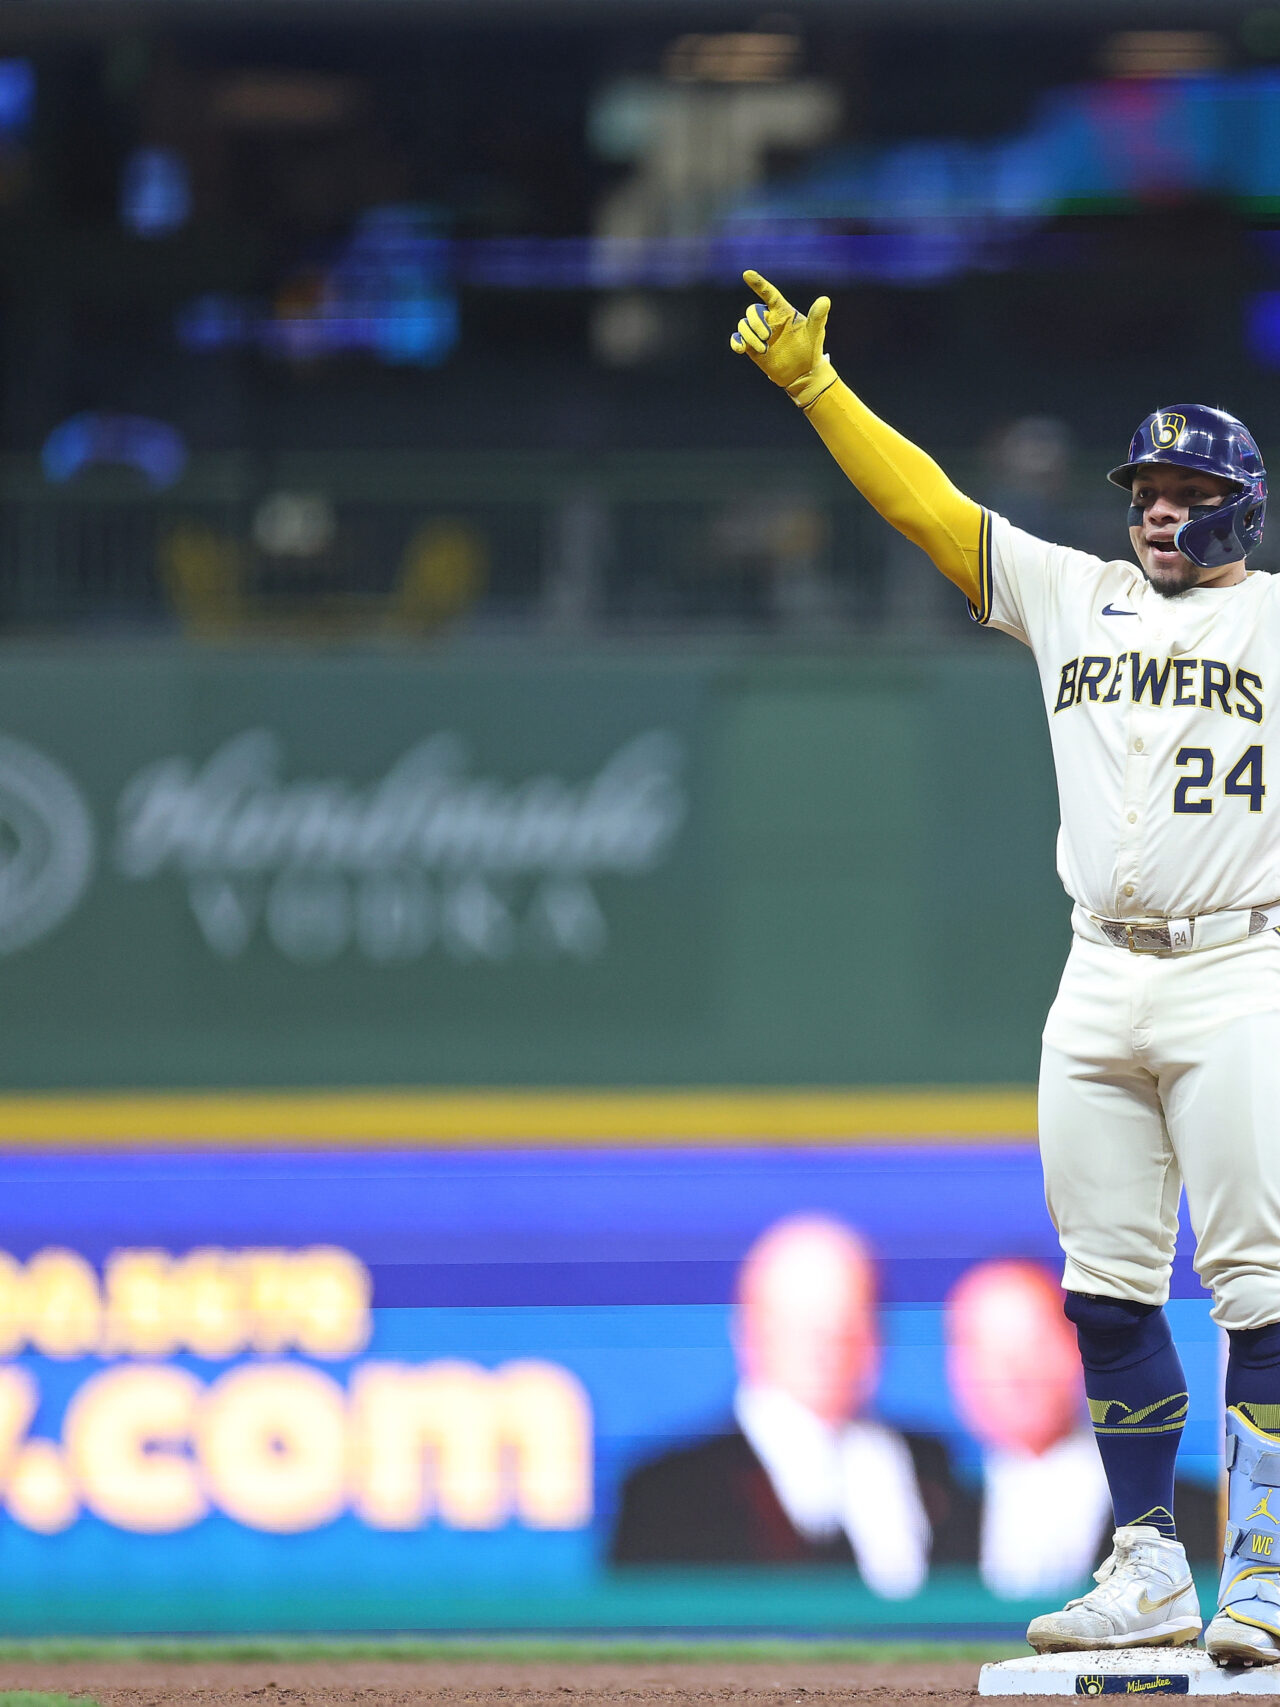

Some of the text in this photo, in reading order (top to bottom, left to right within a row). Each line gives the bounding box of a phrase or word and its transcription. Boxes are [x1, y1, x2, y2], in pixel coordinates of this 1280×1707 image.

[1054, 651, 1265, 726] BREWERS
[1172, 744, 1267, 815] 24
[1173, 931, 1187, 946] 24
[1251, 1534, 1274, 1556] WC
[1126, 1675, 1172, 1693] Milwaukee
